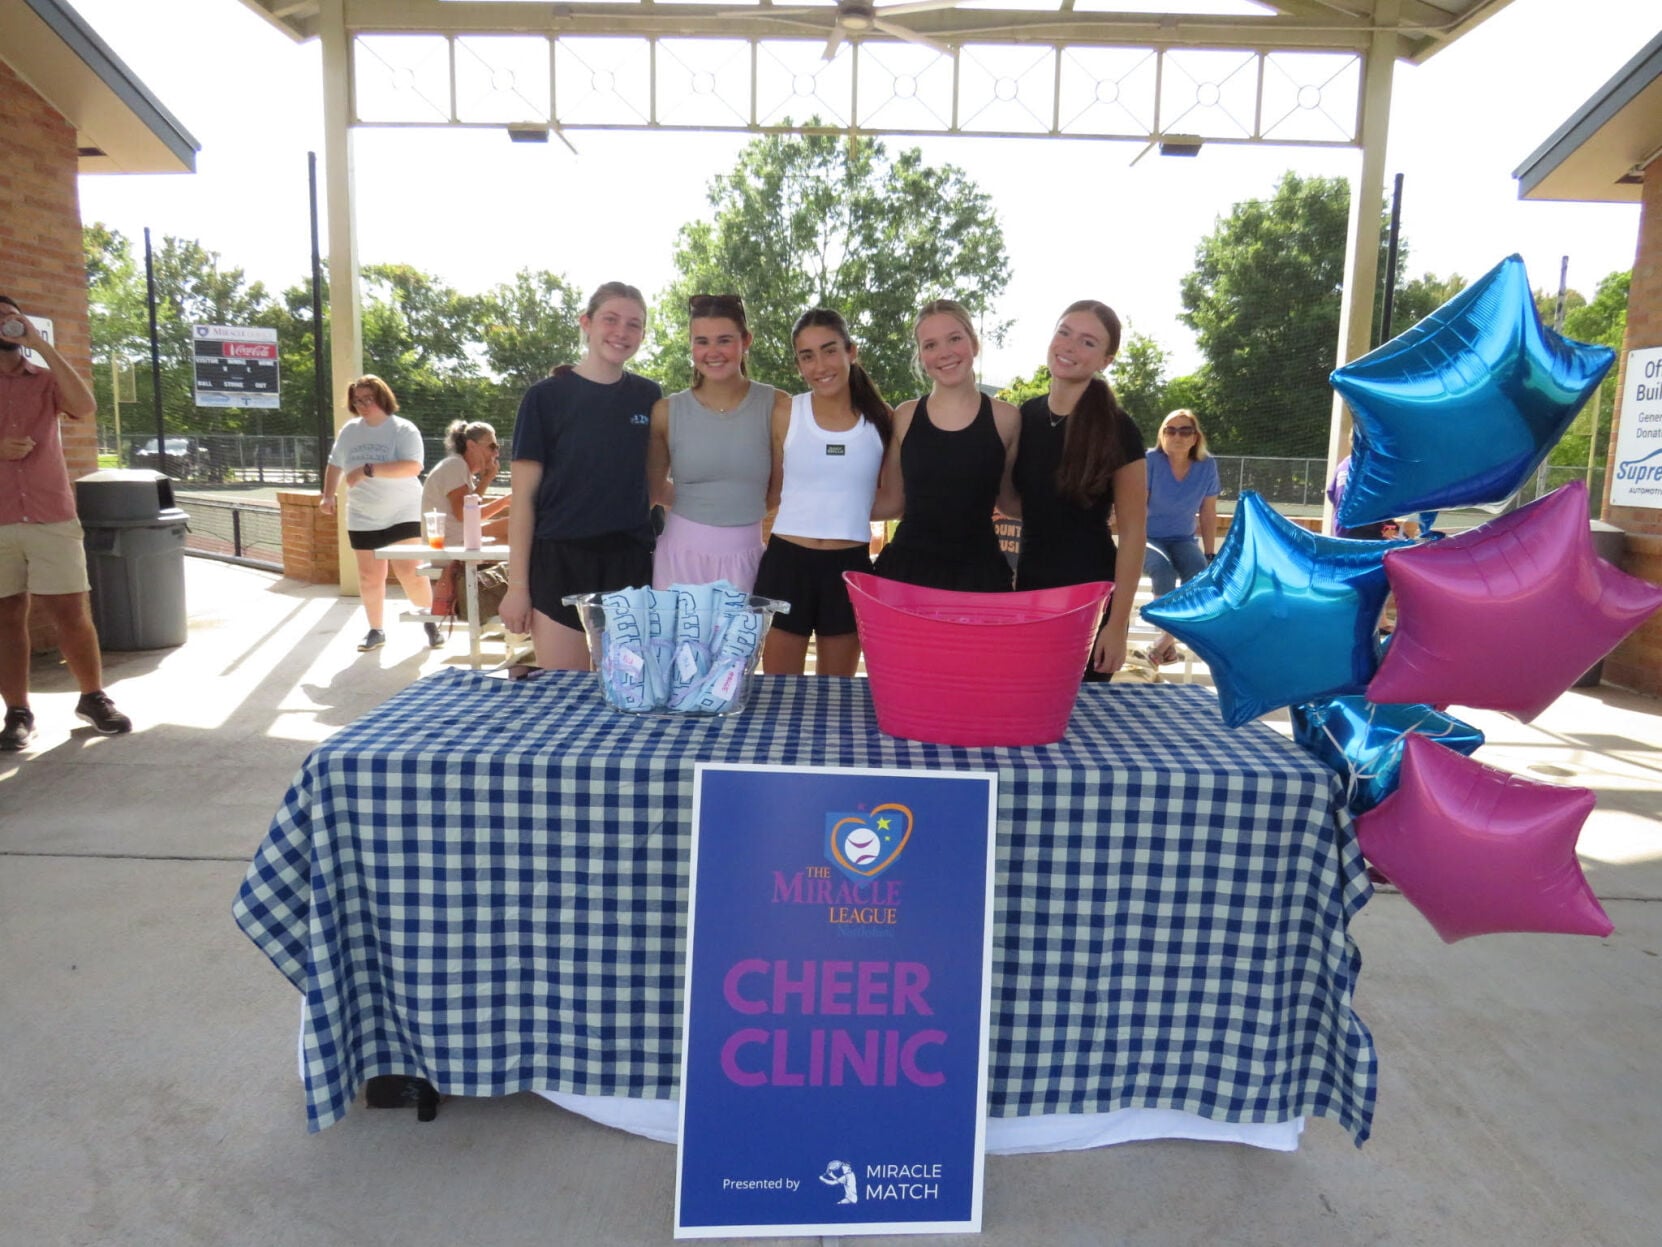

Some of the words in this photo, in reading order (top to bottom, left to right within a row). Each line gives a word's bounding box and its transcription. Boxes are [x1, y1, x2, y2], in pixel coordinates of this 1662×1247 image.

[806, 866, 832, 879] THE
[771, 870, 903, 906] MIRACLE
[829, 906, 897, 924] LEAGUE
[723, 958, 935, 1016] CHEER
[720, 1027, 948, 1087] CLINIC
[866, 1163, 943, 1179] MIRACLE
[722, 1177, 783, 1190] Presented
[785, 1177, 800, 1192] by
[865, 1183, 939, 1200] MATCH
